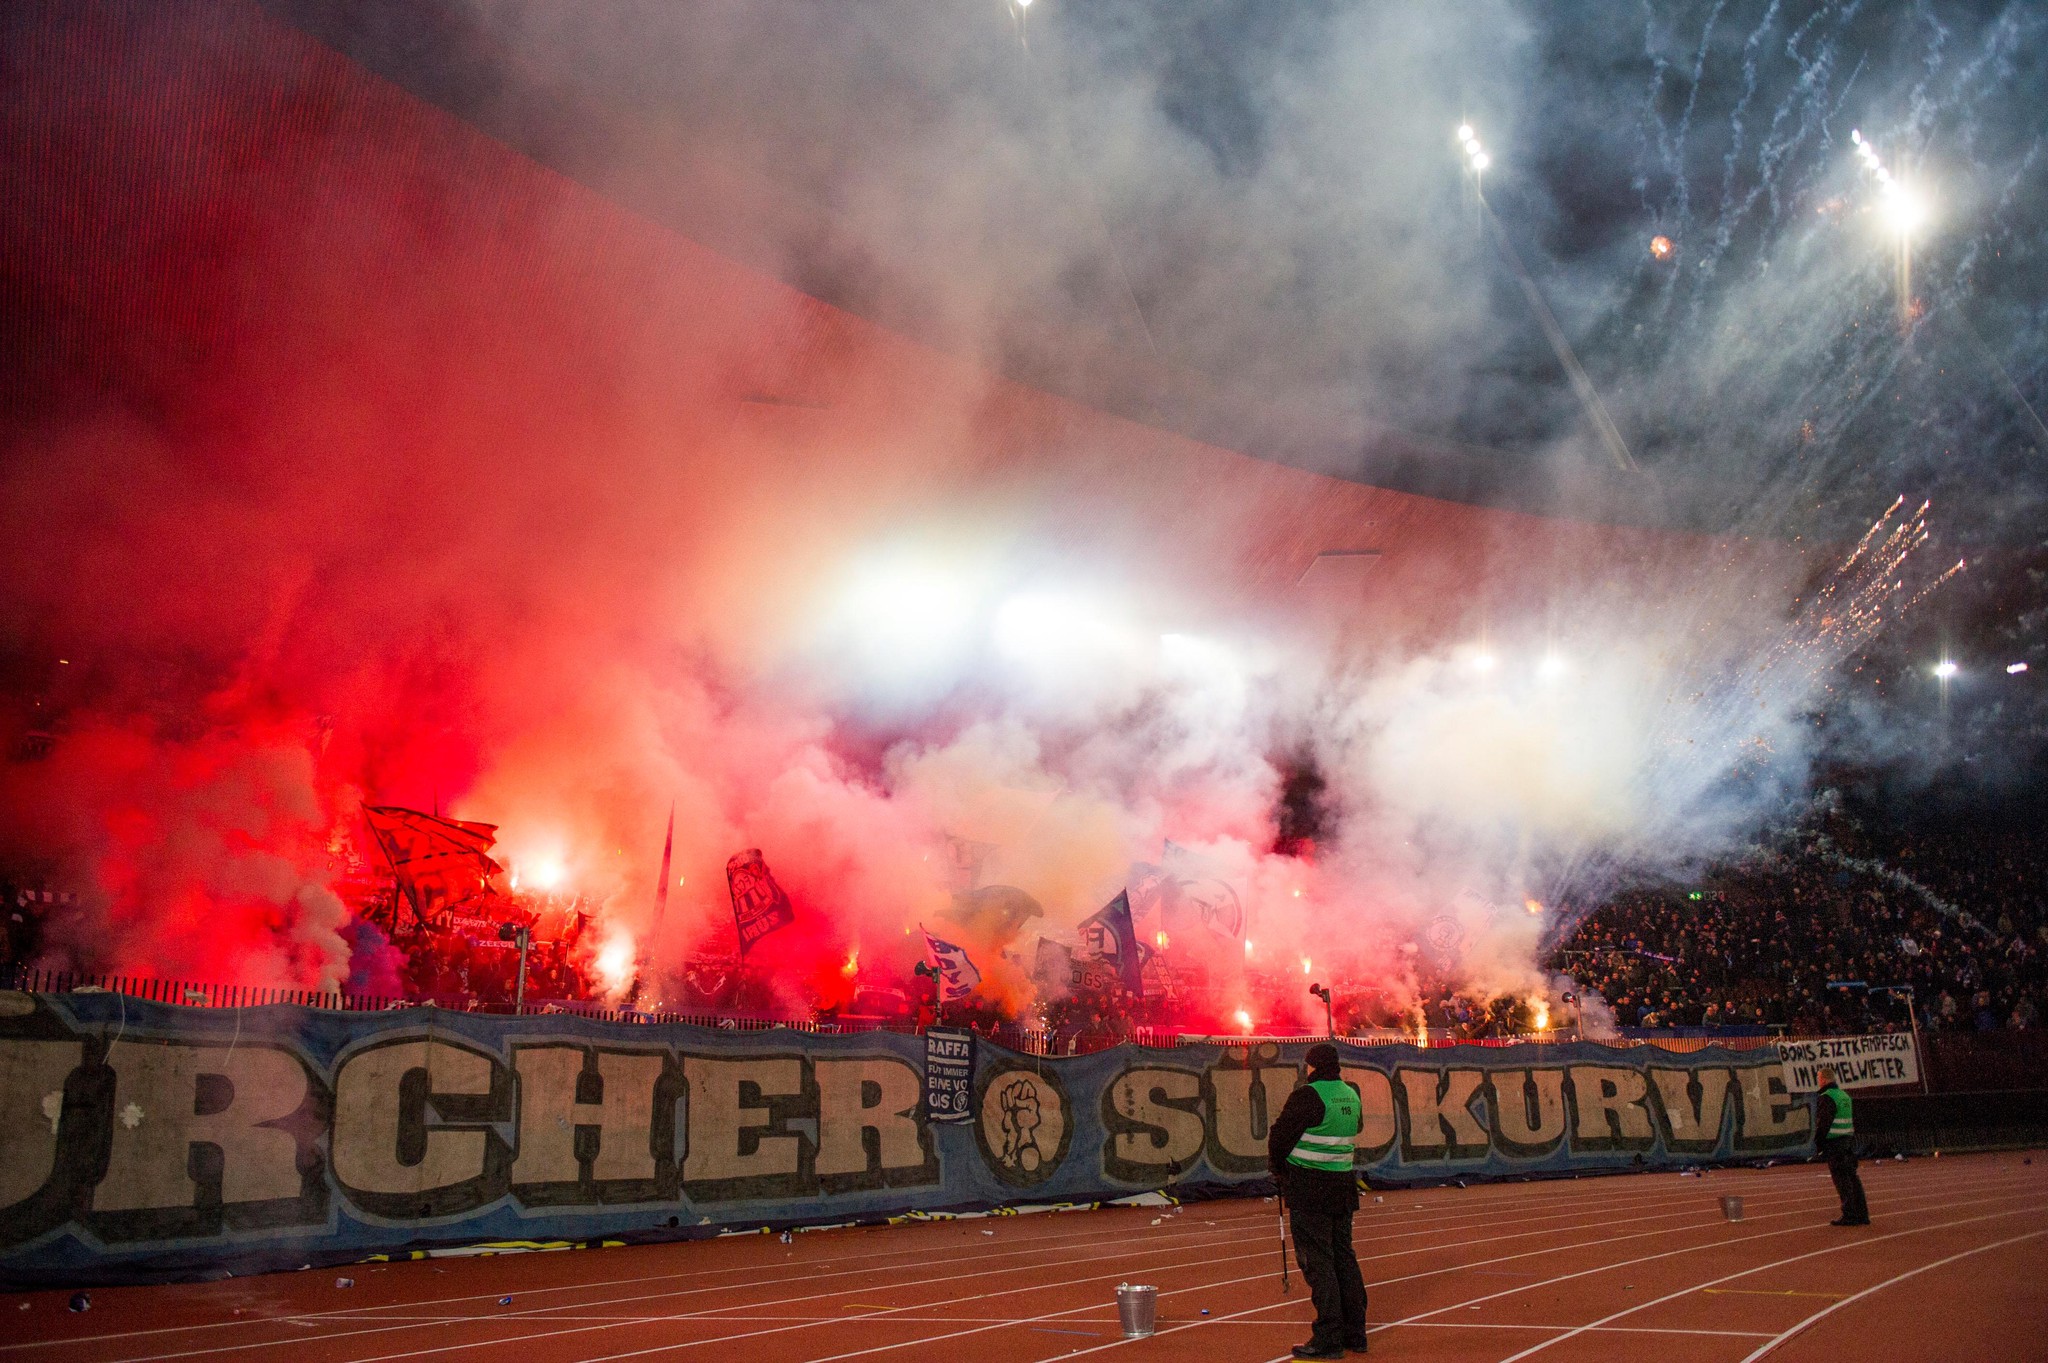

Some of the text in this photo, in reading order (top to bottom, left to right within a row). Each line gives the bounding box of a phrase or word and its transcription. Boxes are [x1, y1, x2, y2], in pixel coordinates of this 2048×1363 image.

[928, 1038, 969, 1057] RAFFA
[1780, 1043, 1817, 1062] BORIS
[943, 1067, 969, 1077] IMMER
[929, 1076, 952, 1091] EINE
